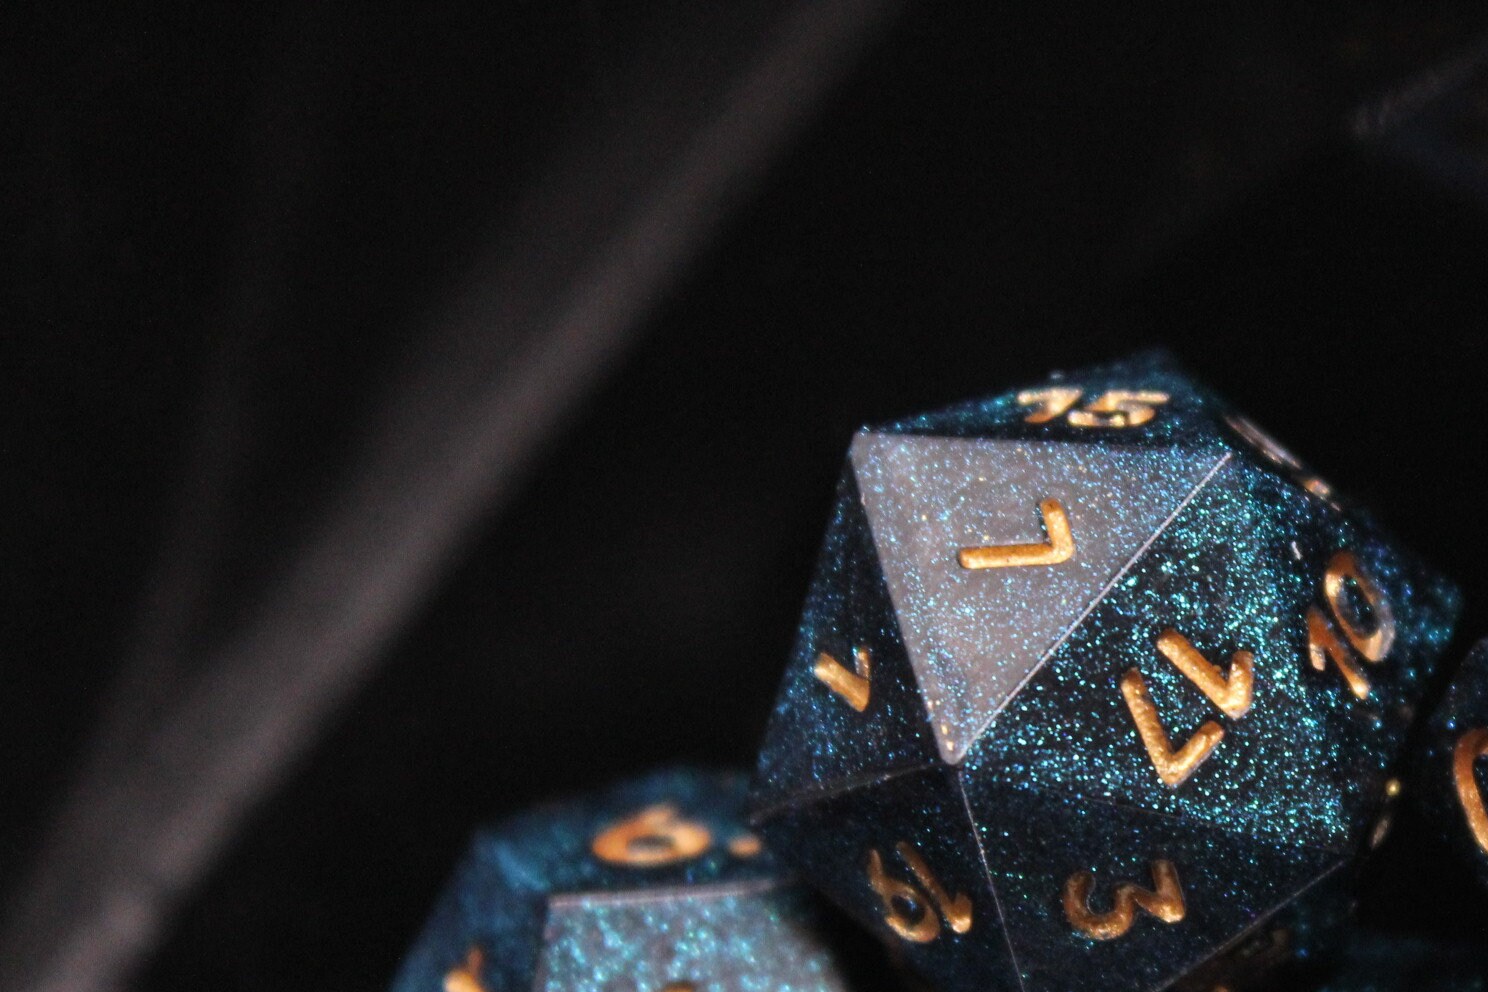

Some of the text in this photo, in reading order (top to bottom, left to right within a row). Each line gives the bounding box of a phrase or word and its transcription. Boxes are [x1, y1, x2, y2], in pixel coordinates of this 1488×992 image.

[1018, 388, 1168, 430] 15
[1306, 551, 1394, 701] 10
[1119, 627, 1256, 787] 17
[1063, 859, 1187, 940] 3
